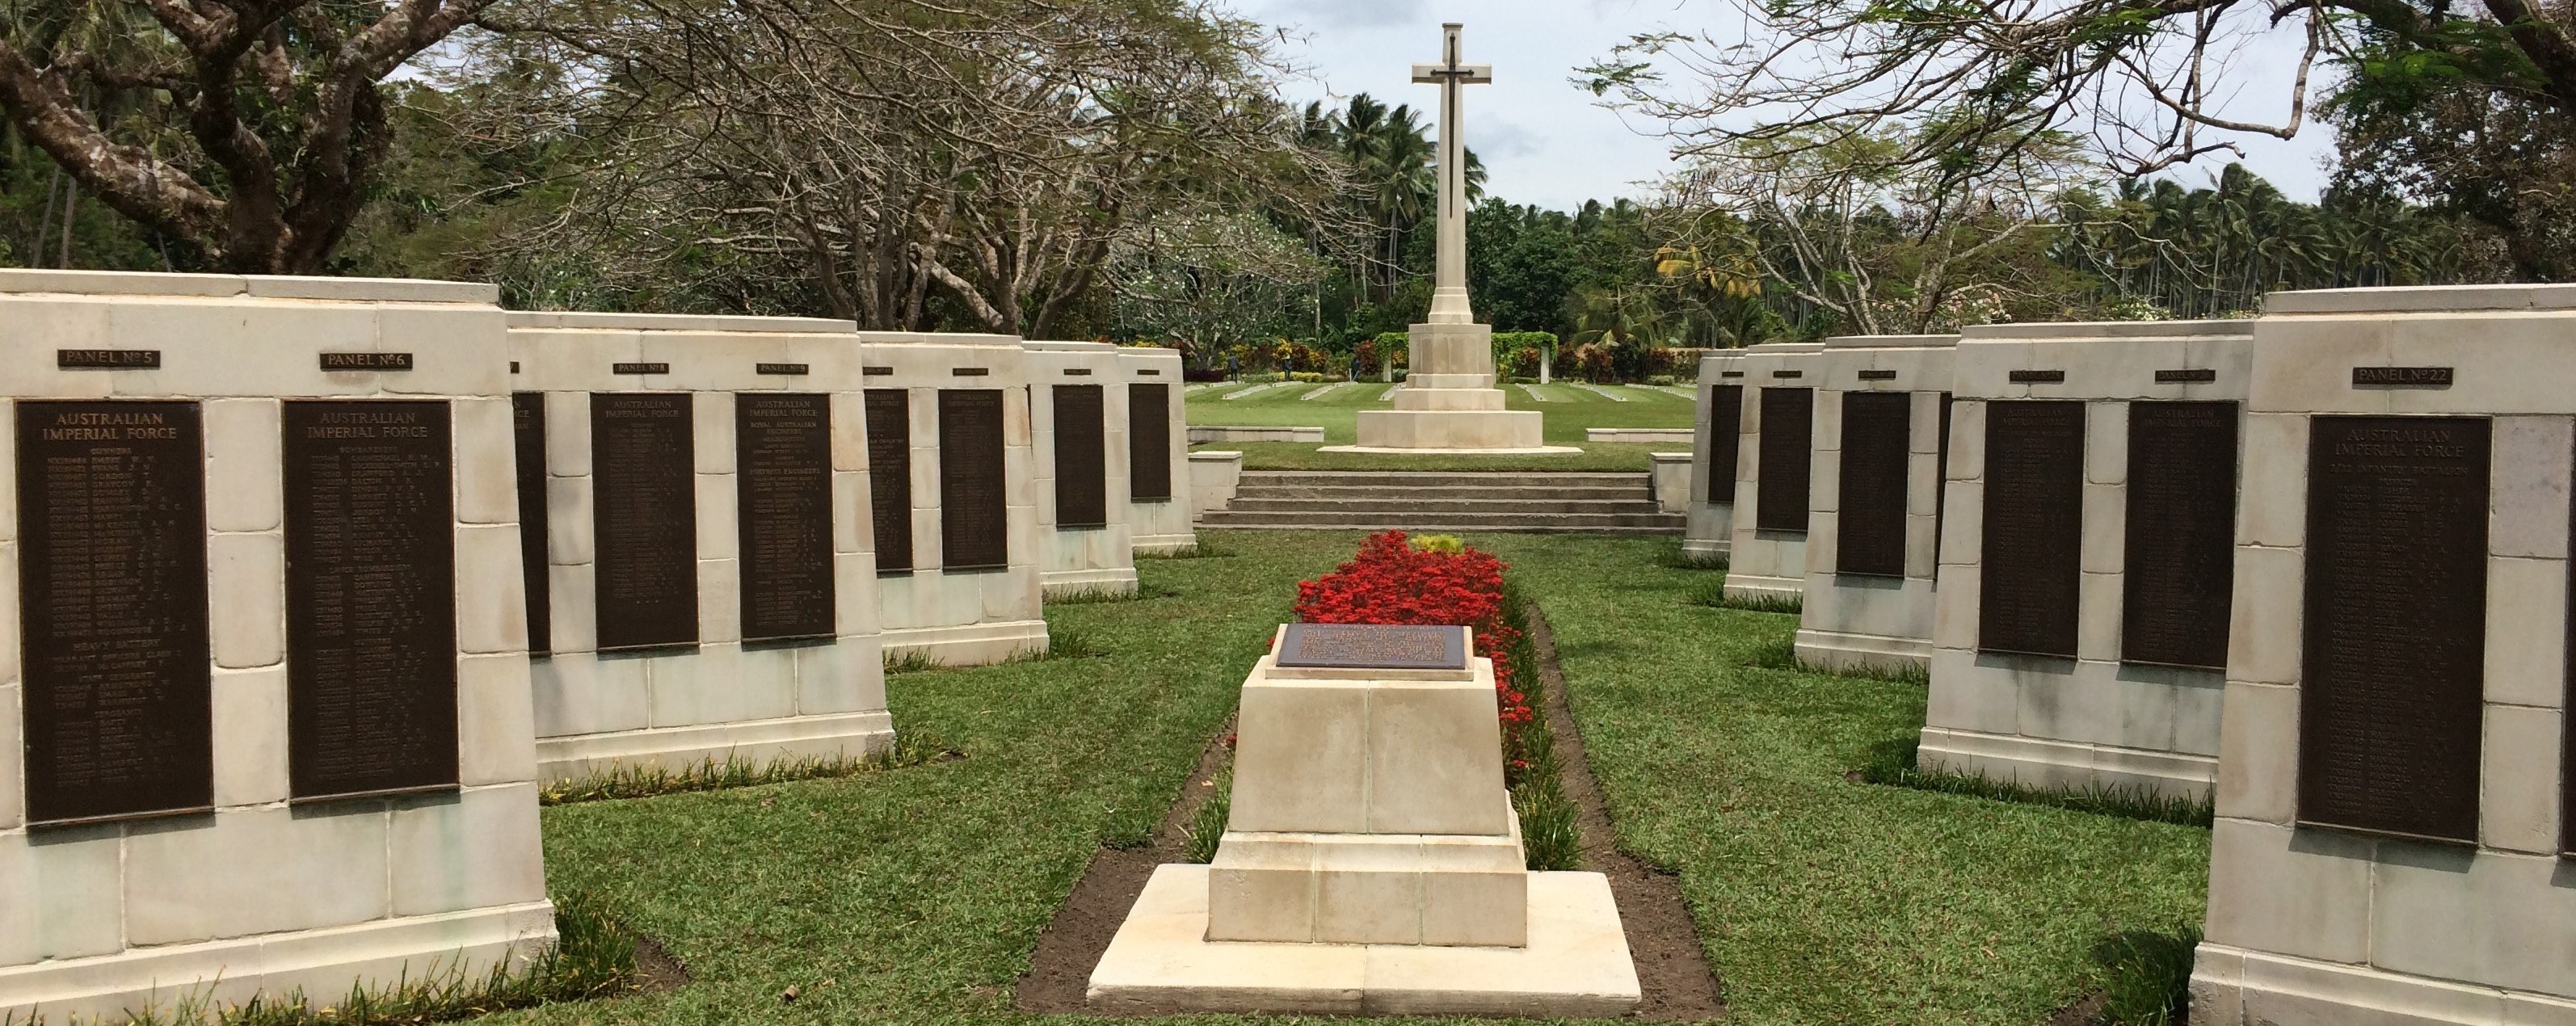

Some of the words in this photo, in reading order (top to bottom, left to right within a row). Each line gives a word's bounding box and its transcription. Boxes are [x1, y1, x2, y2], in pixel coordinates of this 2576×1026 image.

[65, 351, 118, 364] PANEL
[328, 354, 375, 364] PANEL
[619, 364, 646, 372] PANEL
[2359, 369, 2406, 381] PANEL
[614, 401, 671, 409] AUSTRALIAN
[57, 413, 163, 425] AUSTRALIAN
[320, 412, 415, 424] AUSTRALIAN
[606, 410, 647, 418] IMPERIAL
[651, 410, 680, 418] FORCE
[749, 409, 789, 417] IMPERIAL
[792, 409, 819, 417] FORCE
[43, 427, 120, 440] IMPERIAL
[127, 427, 177, 439] FORCE
[307, 427, 376, 439] IMPERIAL
[381, 426, 427, 438] FORCE
[2346, 429, 2451, 443] AUSTRALIAN
[2334, 444, 2407, 456] IMPERIAL
[2414, 445, 2464, 458] FORCE
